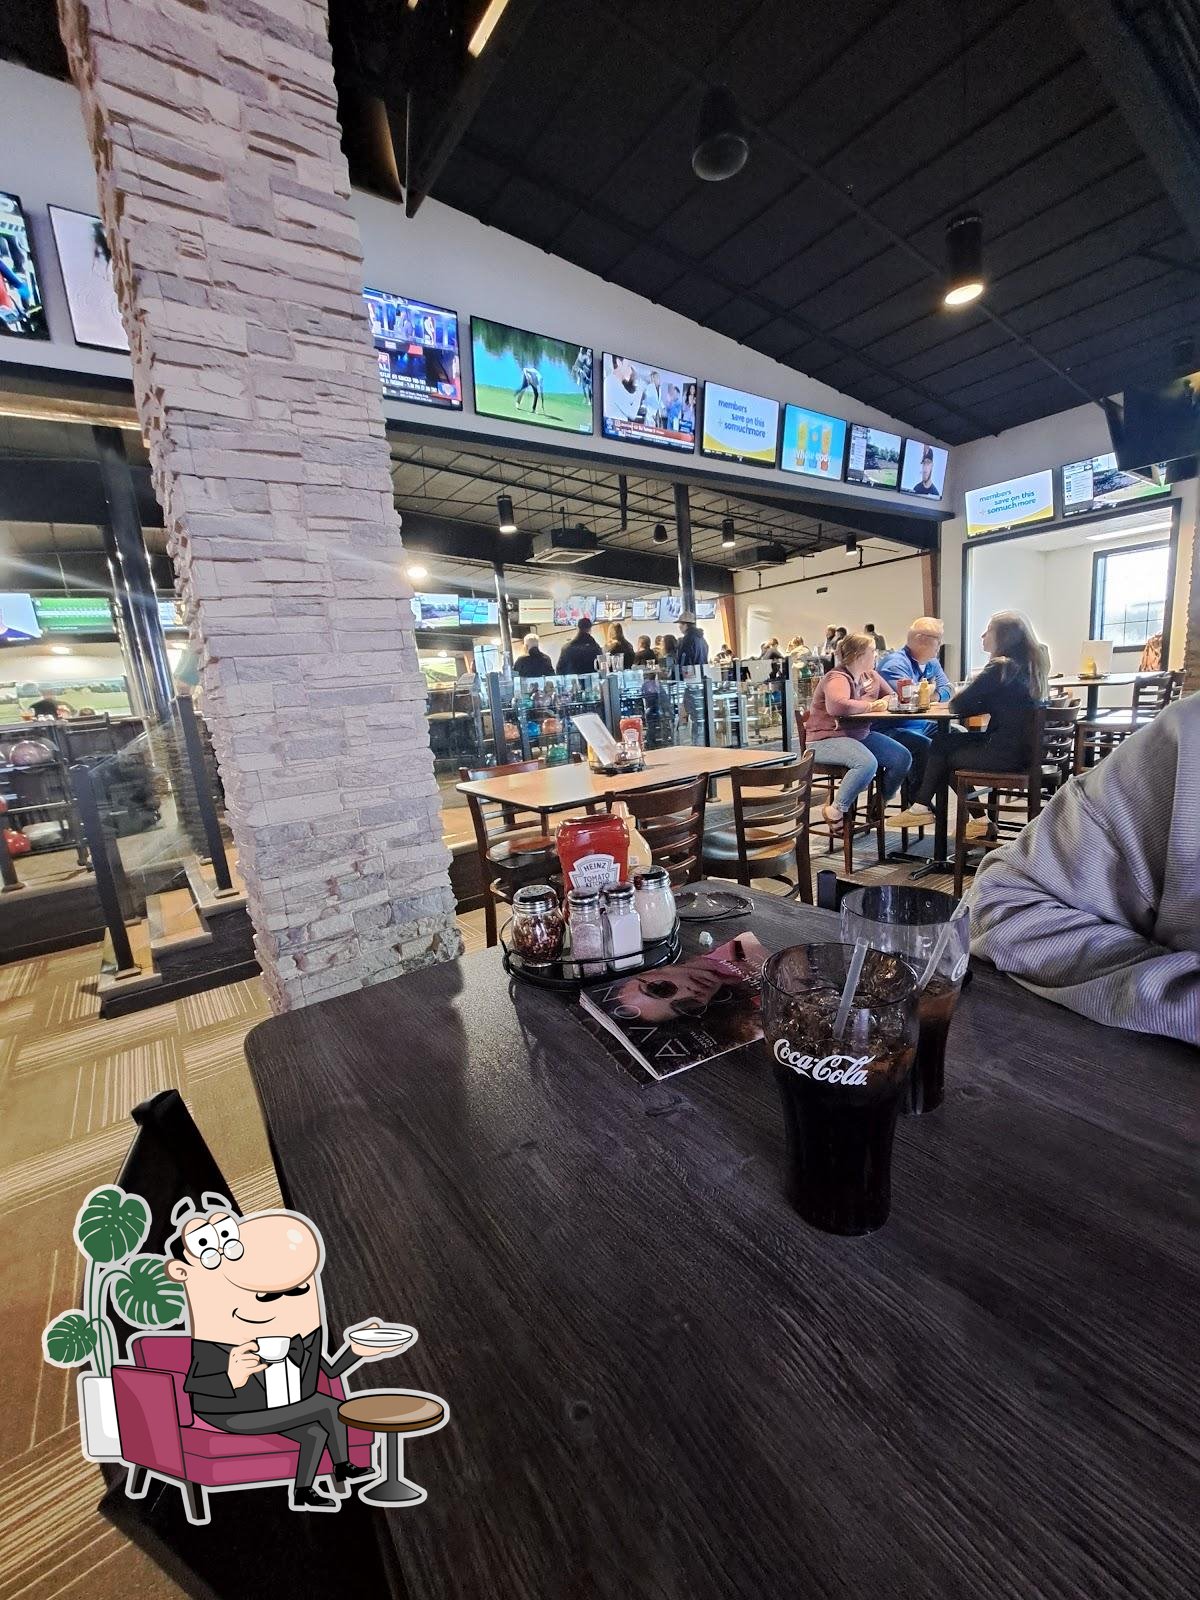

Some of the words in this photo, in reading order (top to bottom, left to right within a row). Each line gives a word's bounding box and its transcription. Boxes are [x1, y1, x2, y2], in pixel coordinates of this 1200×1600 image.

[718, 400, 748, 413] members
[731, 413, 745, 422] save
[754, 416, 765, 428] this
[980, 489, 1012, 502] members
[1010, 494, 1020, 502] on
[1021, 491, 1035, 499] this
[583, 862, 607, 872] HEINZ
[583, 872, 610, 883] TOMATO
[601, 987, 691, 1059] AVON
[773, 1038, 876, 1086] Coca-Cola
